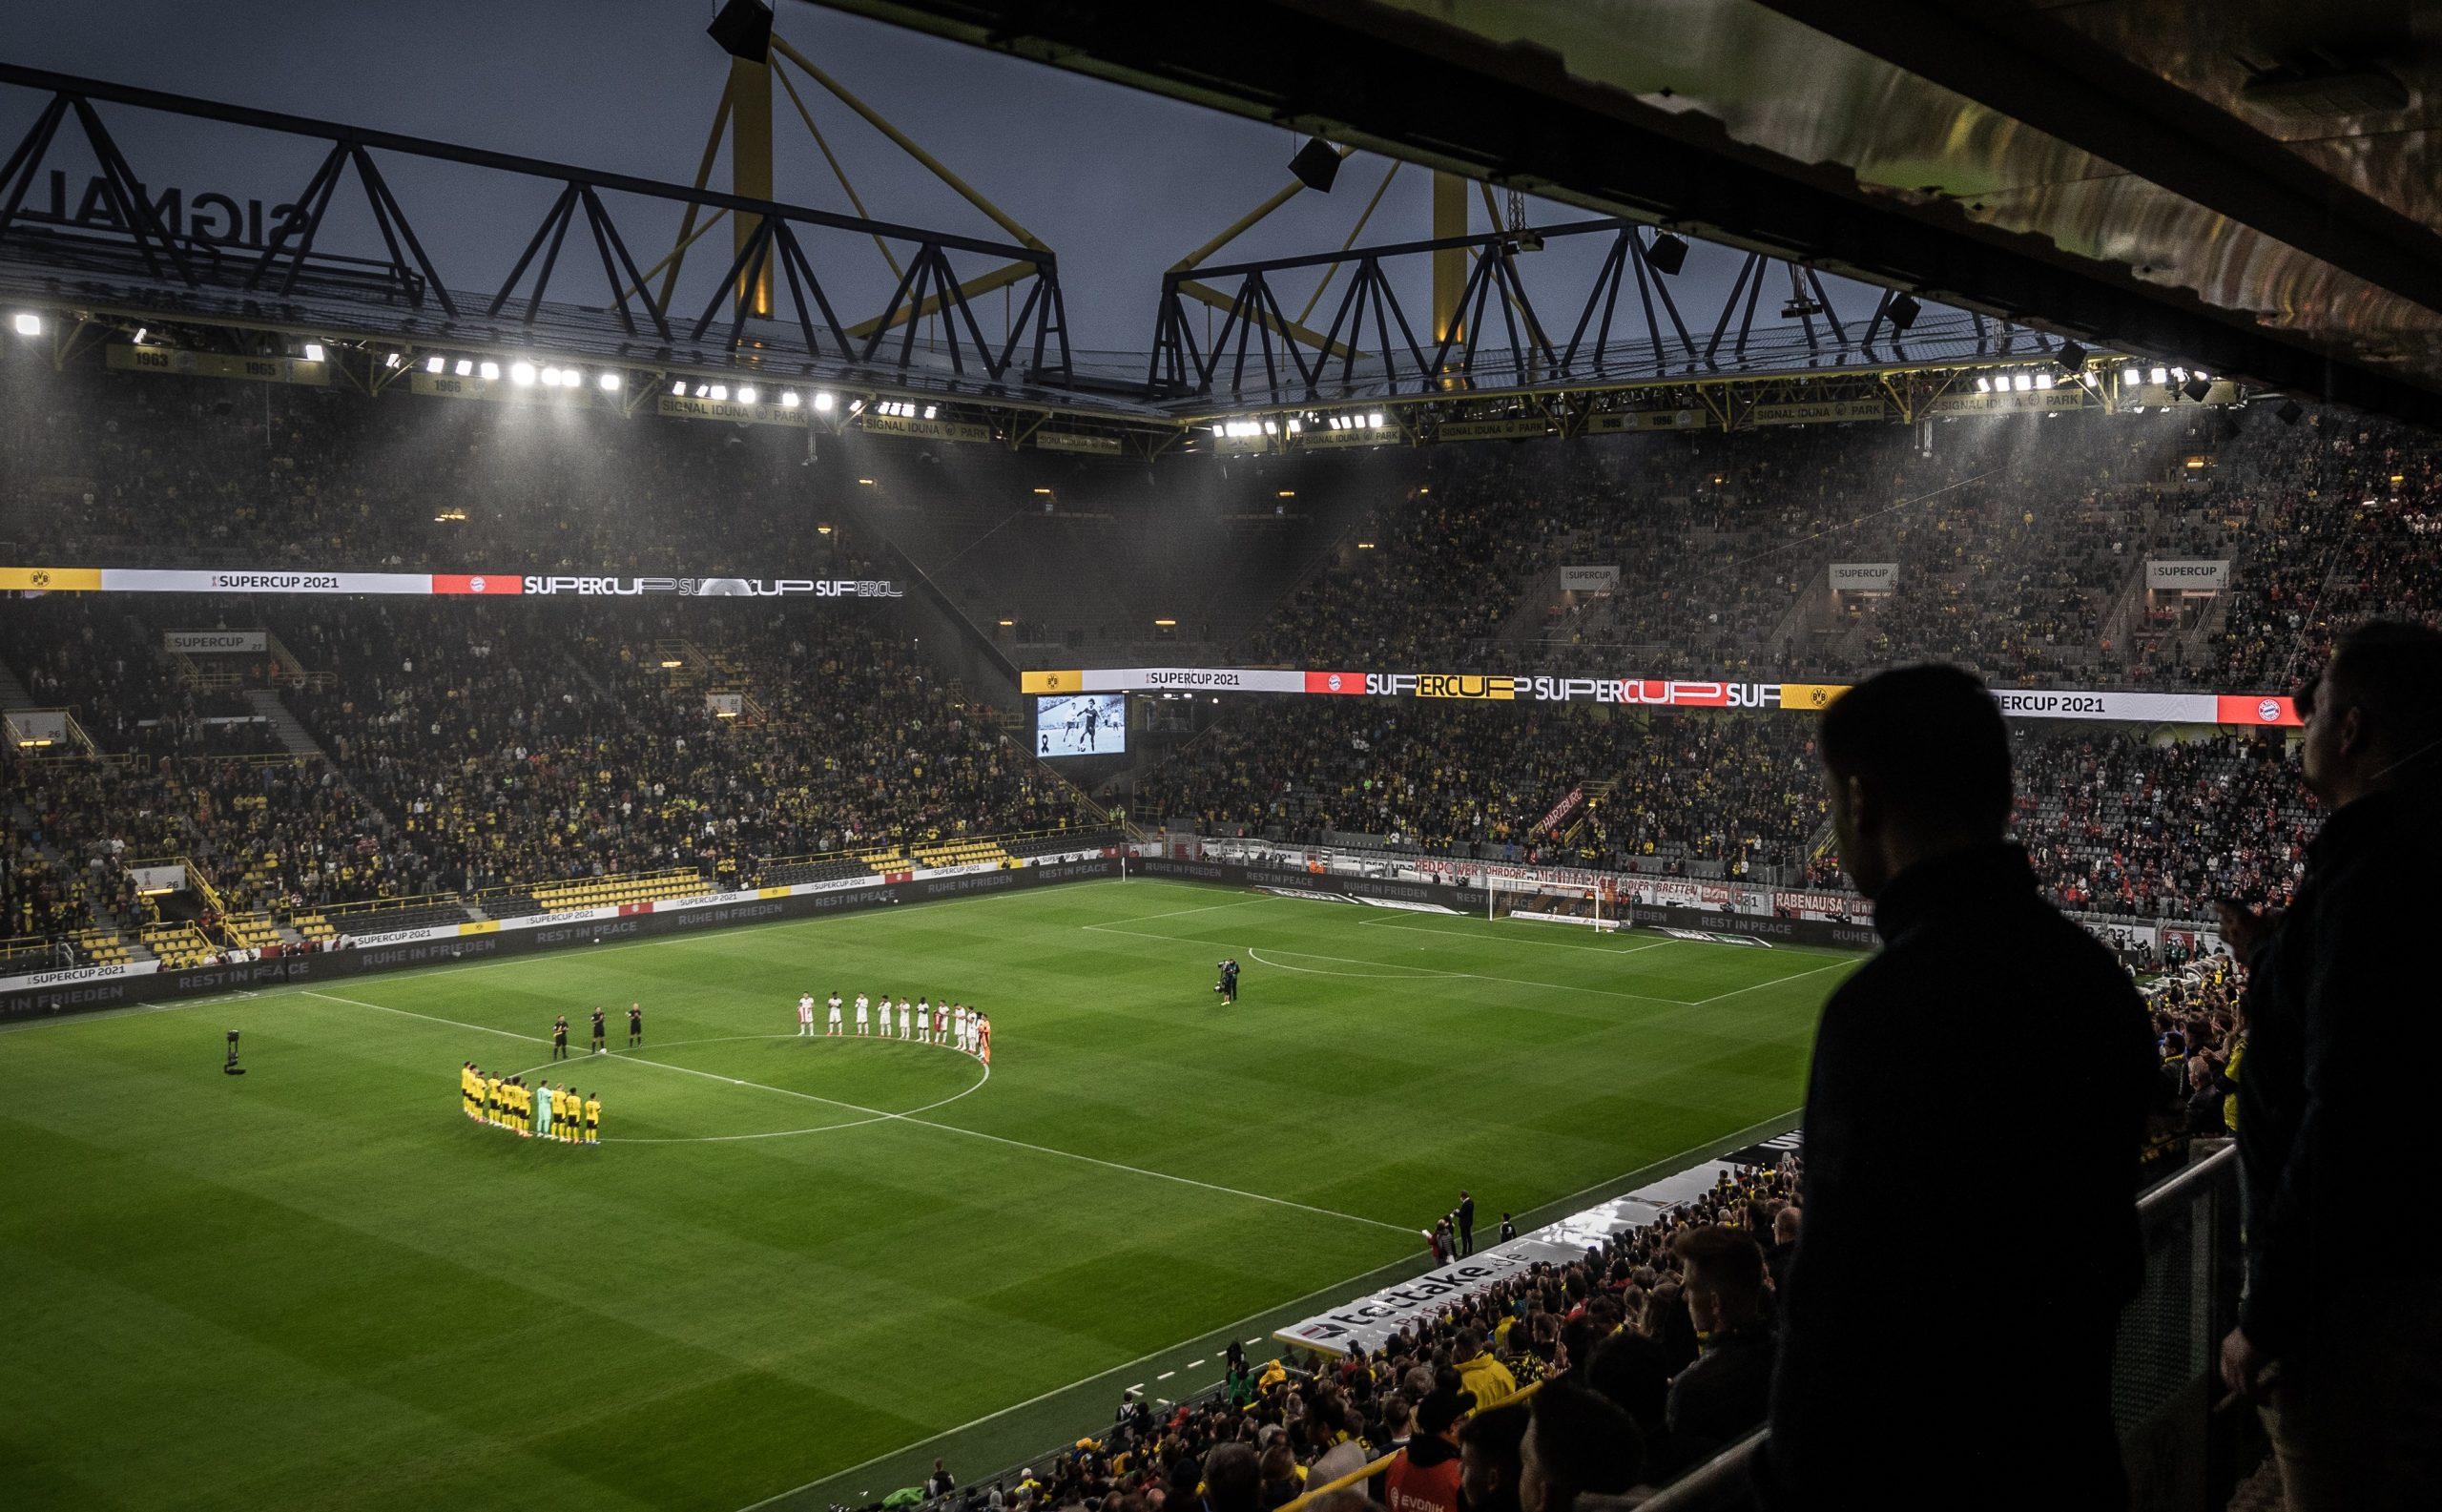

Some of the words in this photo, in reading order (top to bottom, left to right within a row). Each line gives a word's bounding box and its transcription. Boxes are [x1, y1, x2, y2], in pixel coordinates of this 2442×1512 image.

[135, 352, 169, 367] 1963
[245, 362, 277, 376] 1965
[1941, 399, 1983, 411] SIGNAL
[2046, 394, 2079, 406] PARK
[662, 400, 709, 416] SIGNAL
[712, 404, 749, 419] IDUNA
[774, 410, 805, 424] PARK
[1757, 408, 1794, 420] SIGNAL
[1797, 406, 1830, 418] IDUNA
[1852, 404, 1881, 416] PARK
[866, 418, 905, 432] SIGNAL
[908, 422, 940, 436] IDUNA
[961, 428, 988, 440] PARK
[1440, 426, 1473, 437] SIGNAL
[1475, 425, 1501, 435] IDUNA
[1519, 422, 1542, 433] PARK
[1306, 434, 1334, 445] SIGNAL
[1335, 432, 1360, 443] IDUNA
[1376, 430, 1398, 442] PARK
[1569, 570, 1611, 579] SUPERCUP
[1839, 569, 1889, 578] SUPERCUP
[2158, 567, 2217, 576] SUPERCUP
[219, 574, 300, 588] SUPERCUP
[303, 576, 340, 589] 2021
[175, 636, 244, 648] SUPERCUP
[1150, 672, 1212, 685] SUPERCUP
[1214, 673, 1240, 686] 2021
[1535, 677, 1722, 705] SUPERCUP
[2061, 697, 2106, 713] 2021
[1542, 787, 1584, 832] HARZBURG
[1039, 869, 1064, 879] REST
[1065, 867, 1074, 877] IN
[1075, 863, 1107, 875] PEACE
[1145, 861, 1170, 873] RUHE
[1173, 864, 1183, 874] IN
[1185, 866, 1222, 878] FRIEDEN
[166, 880, 179, 889] 26
[928, 882, 956, 894] RUHE
[959, 880, 969, 890] IN
[971, 875, 1013, 888] FRIEDEN
[1246, 871, 1270, 882] REST
[1272, 874, 1282, 883] IN
[1283, 875, 1314, 887] PEACE
[816, 895, 844, 907] REST
[847, 893, 859, 904] IN
[860, 888, 896, 901] PEACE
[1343, 881, 1370, 893] RUHE
[1373, 884, 1382, 894] IN
[1384, 886, 1428, 898] FRIEDEN
[679, 894, 720, 907] SUPERCUP
[719, 892, 737, 902] 2021
[1457, 892, 1482, 904] REST
[530, 911, 572, 925] SUPERCUP
[573, 909, 594, 921] 2021
[678, 911, 713, 926] RUHE
[715, 909, 730, 922] IN
[732, 902, 783, 920] FRIEDEN
[537, 928, 572, 943] REST
[575, 925, 590, 939] IN
[593, 921, 638, 937] PEACE
[1702, 917, 1733, 929] REST
[1735, 920, 1749, 930] IN
[1750, 922, 1792, 935] PEACE
[358, 931, 407, 945] SUPERCUP
[408, 929, 432, 940] 2021
[1832, 929, 1869, 943] RUHE
[362, 949, 406, 966] RUHE
[409, 945, 427, 961] IN
[429, 938, 496, 959] FRIEDEN
[32, 968, 96, 984] SUPERCUP
[97, 964, 126, 977] 2021
[178, 973, 227, 989] REST
[230, 970, 248, 984] IN
[254, 962, 310, 981] PEACE
[10, 997, 31, 1011] IN
[37, 985, 124, 1008] FRIEDEN
[1401, 1494, 1445, 1512] EVONIK
